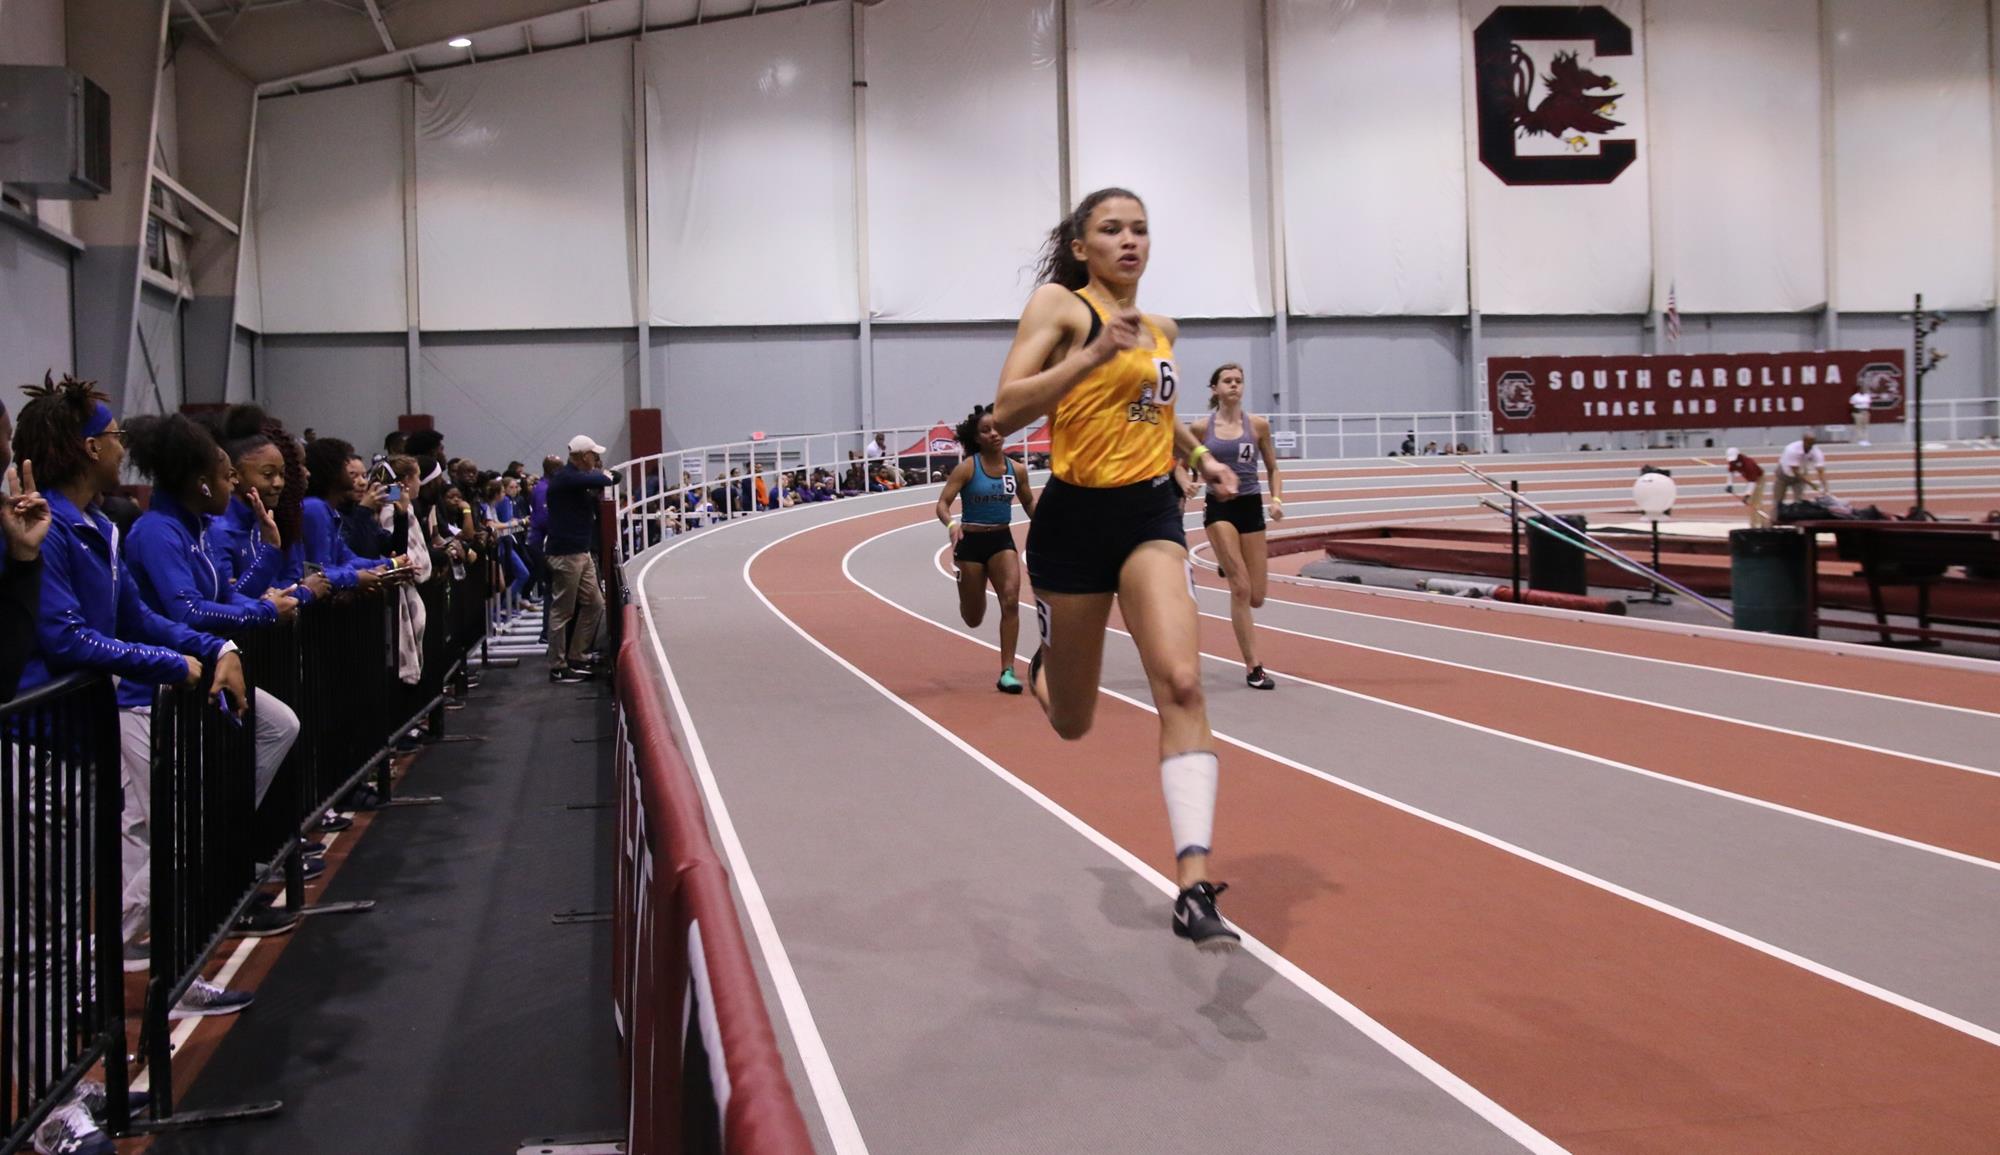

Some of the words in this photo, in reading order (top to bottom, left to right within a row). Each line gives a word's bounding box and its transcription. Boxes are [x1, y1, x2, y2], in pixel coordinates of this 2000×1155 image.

[1160, 361, 1175, 401] 6
[1548, 369, 1652, 390] SOUTH
[1666, 364, 1842, 389] CAROLINA
[1583, 400, 1656, 417] TRACK
[1672, 398, 1717, 415] AND
[1733, 396, 1804, 413] FIELD
[1240, 444, 1250, 461] 4
[1004, 476, 1014, 493] 5
